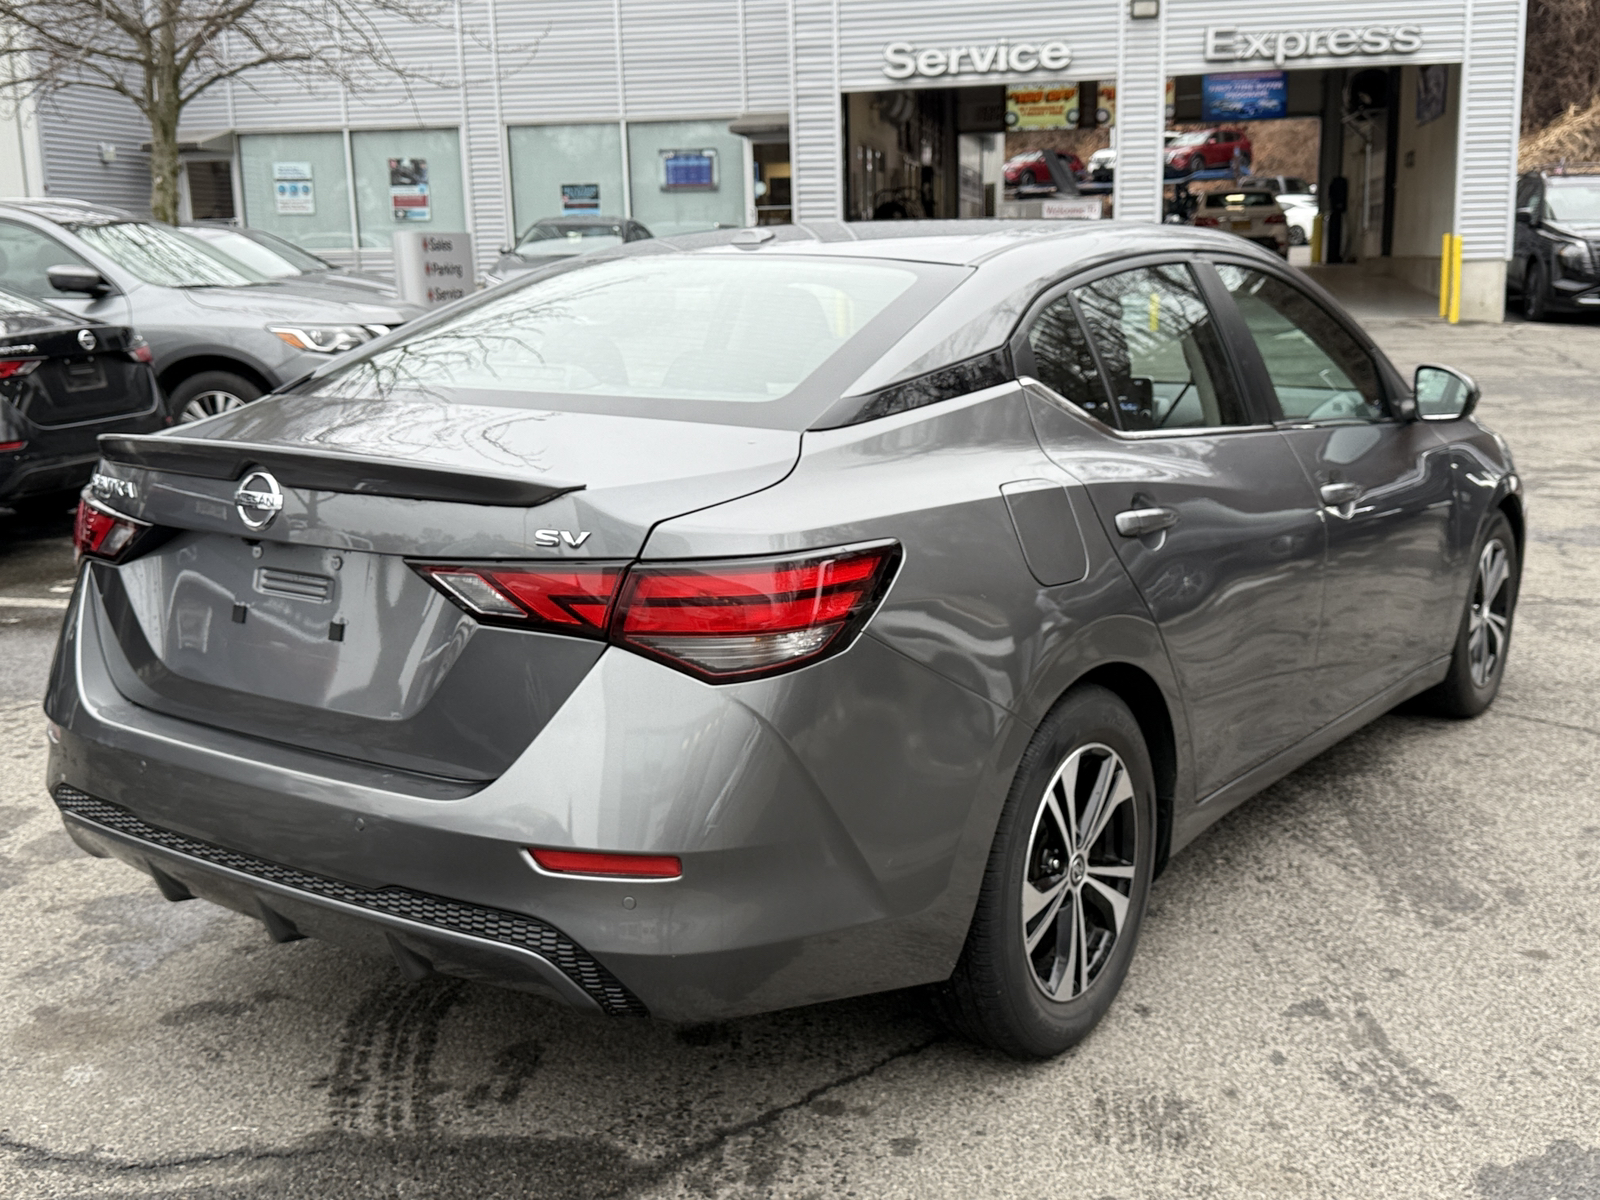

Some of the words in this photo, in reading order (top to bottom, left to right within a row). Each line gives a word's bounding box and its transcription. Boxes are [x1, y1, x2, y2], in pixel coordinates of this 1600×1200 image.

[1205, 24, 1423, 66] Express
[883, 38, 1072, 79] Service
[429, 237, 453, 251] Sales
[432, 262, 463, 279] Parking
[434, 287, 464, 301] Service
[535, 528, 592, 549] SV
